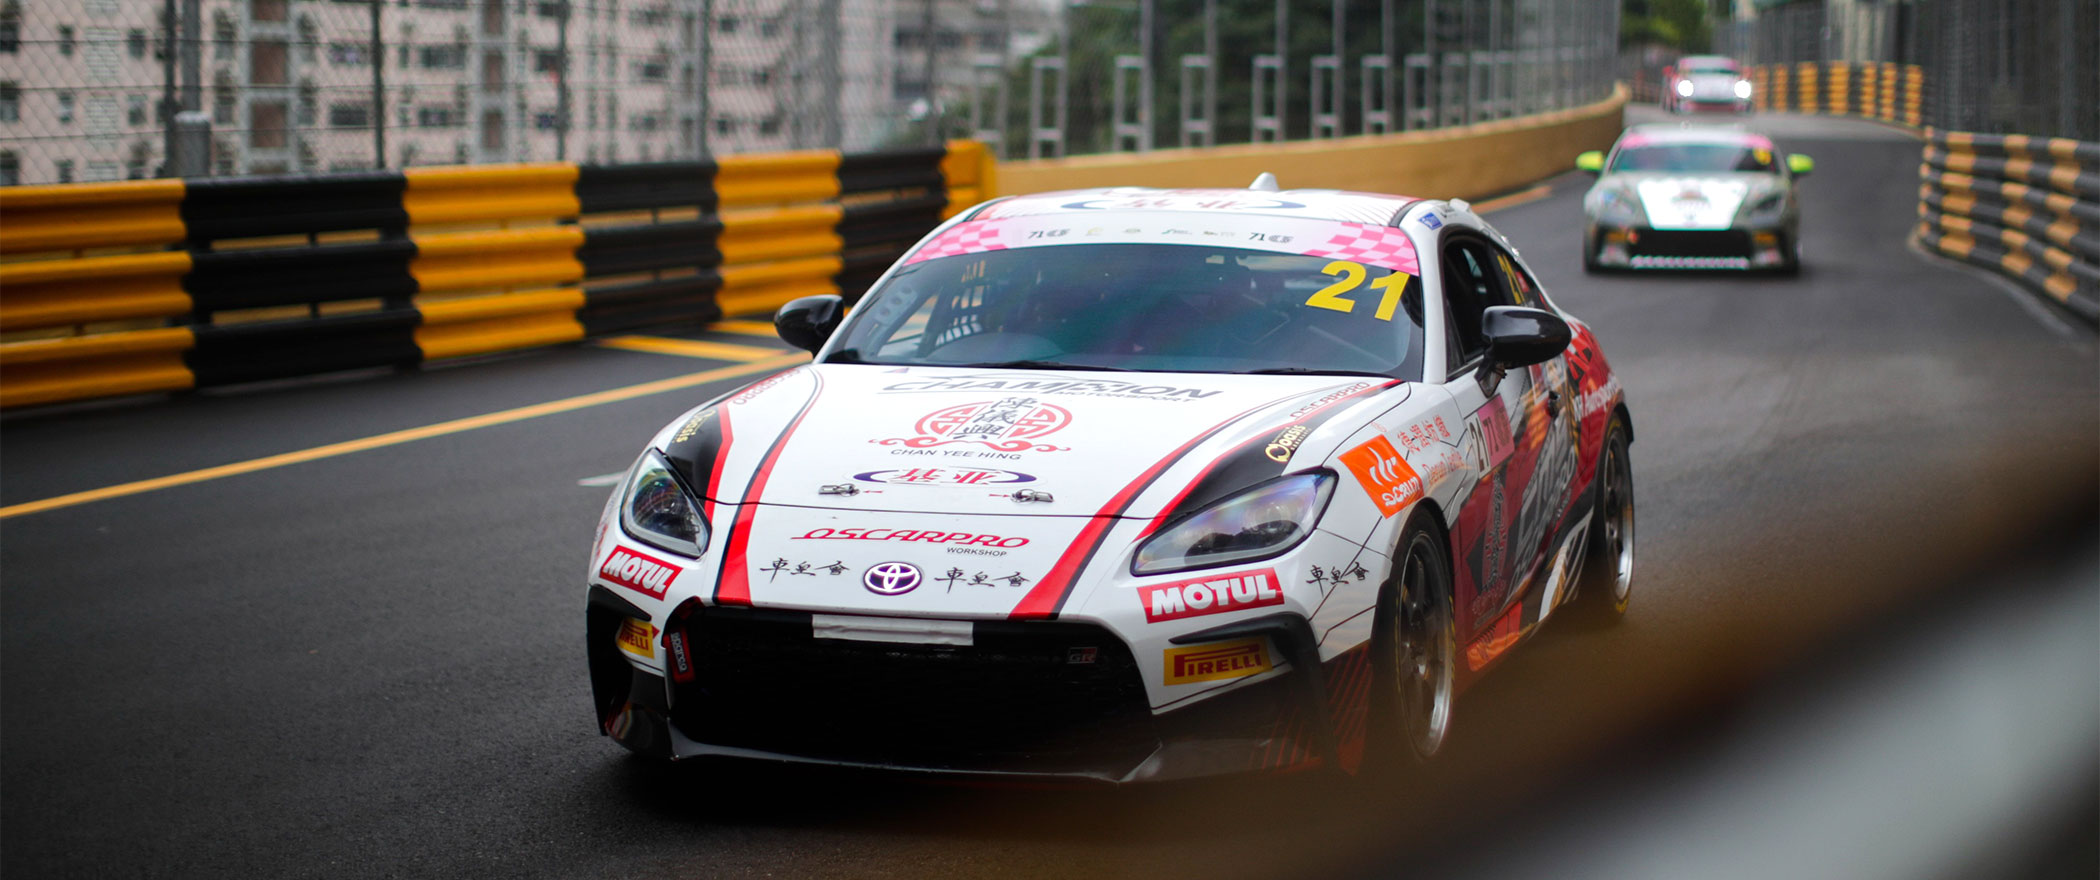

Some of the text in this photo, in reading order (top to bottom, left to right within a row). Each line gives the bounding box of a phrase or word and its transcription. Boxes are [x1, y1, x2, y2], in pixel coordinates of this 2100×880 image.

[1304, 260, 1410, 322] 21
[943, 450, 974, 458] YEE
[978, 452, 1022, 460] HING
[1469, 418, 1489, 473] 21
[791, 528, 1031, 548] OSCARPRO
[946, 547, 1008, 557] WORKSHOP
[602, 551, 674, 593] MOTUL
[1152, 574, 1277, 616] MOTUL
[1174, 643, 1263, 678] PIRELLI
